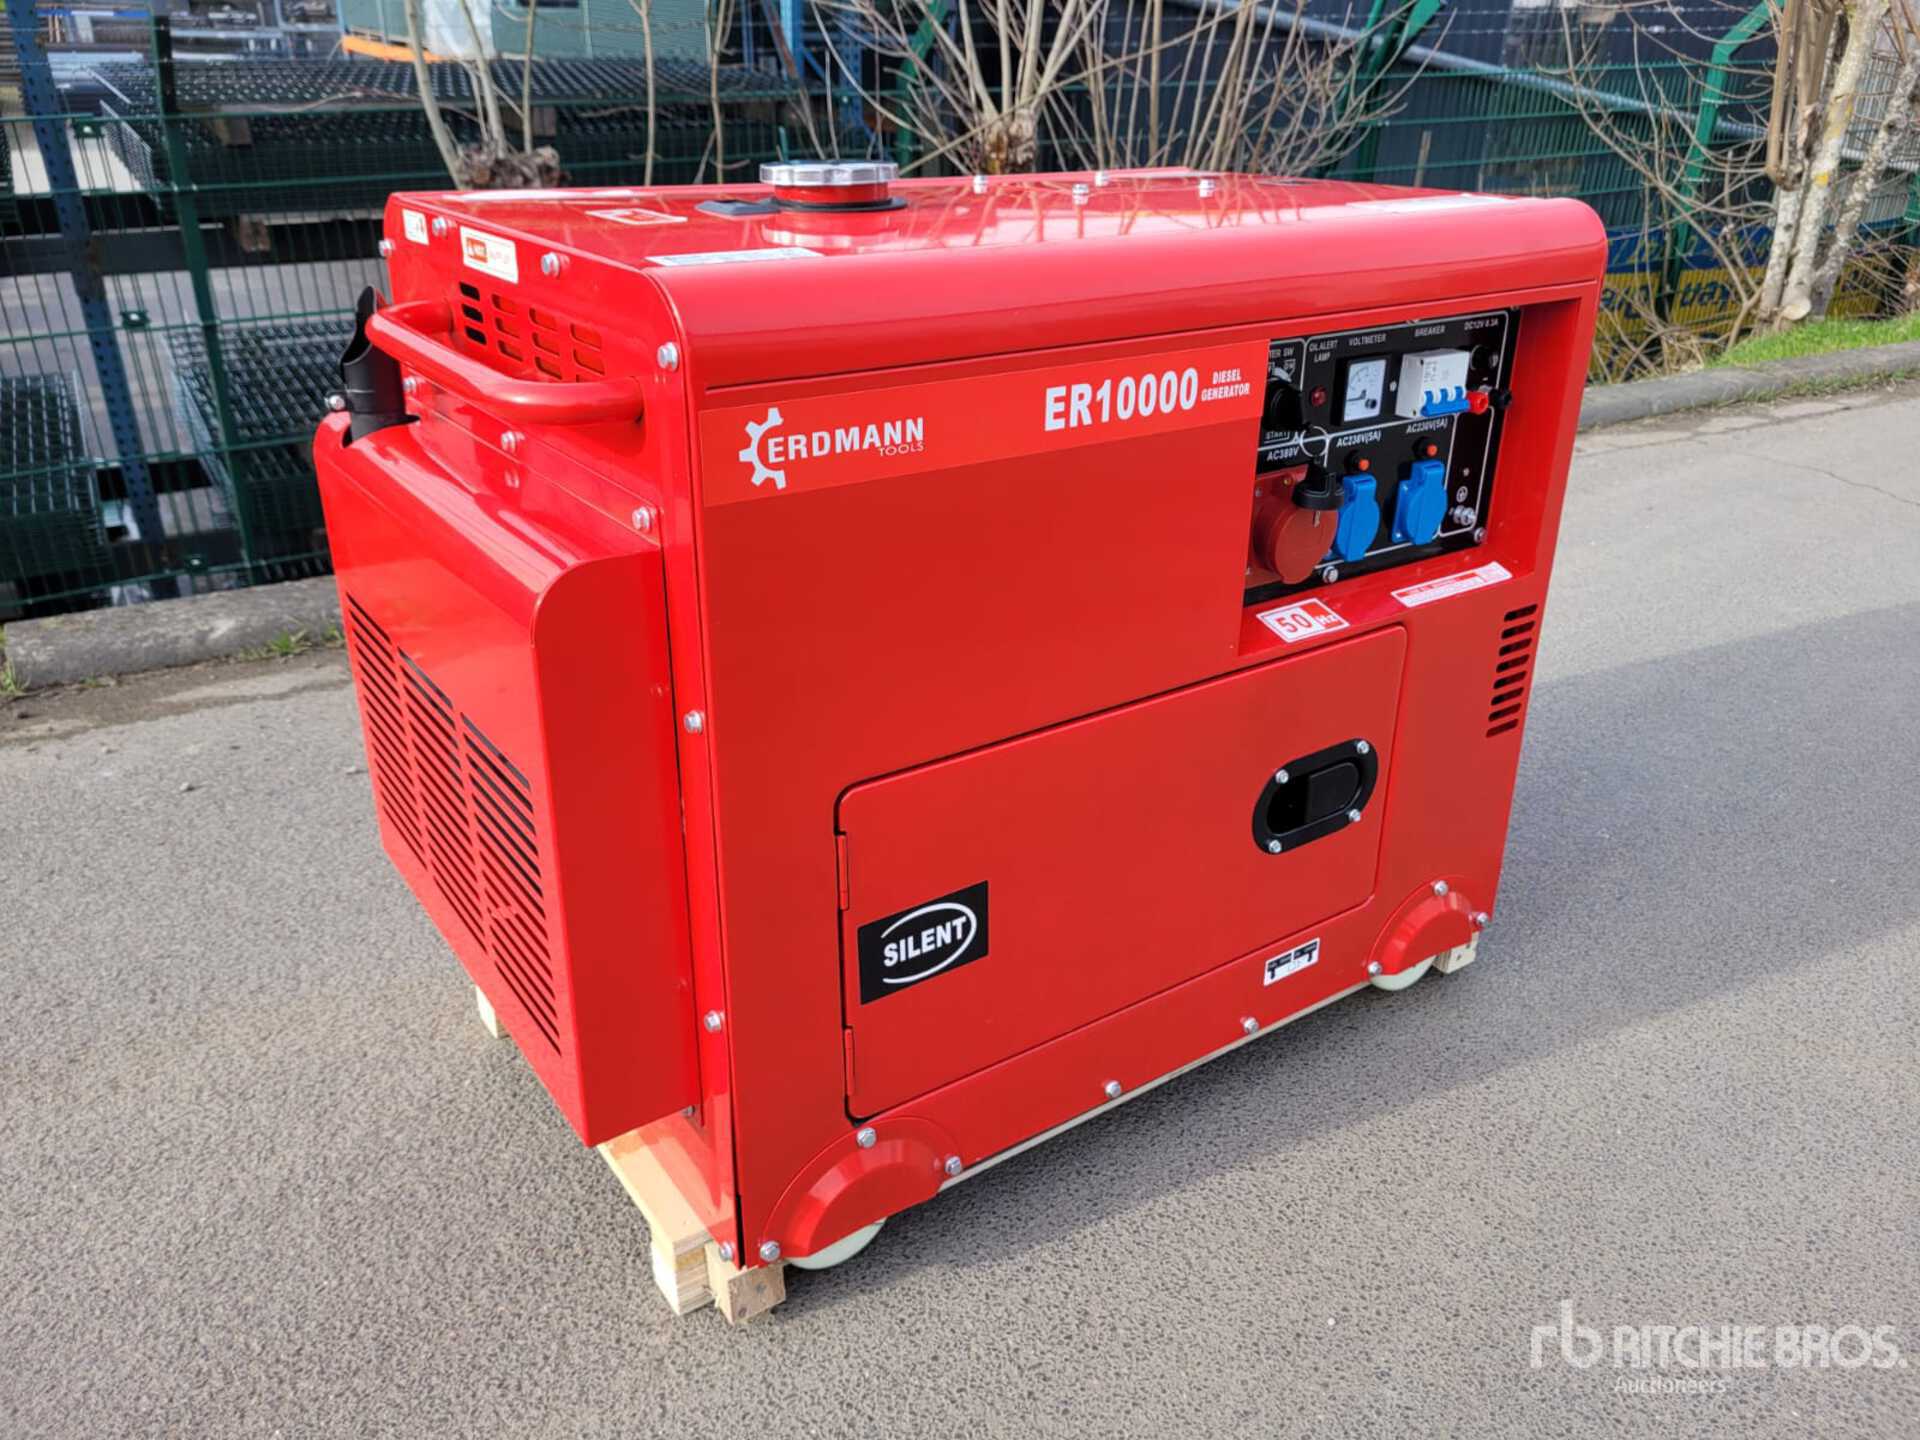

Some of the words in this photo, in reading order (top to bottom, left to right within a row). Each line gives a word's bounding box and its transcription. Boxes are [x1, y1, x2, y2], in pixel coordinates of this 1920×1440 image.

[1349, 333, 1386, 346] VOLTMETER
[1414, 325, 1446, 338] BREAKER
[1313, 351, 1331, 363] LAMP
[1212, 369, 1242, 385] DIESEL
[1043, 367, 1198, 432] ER10000
[1201, 382, 1250, 402] GENERATOR
[767, 417, 924, 465] ERDMANN
[878, 441, 925, 457] TOOLS
[1266, 446, 1300, 462] AC380V
[1275, 612, 1312, 633] 50
[883, 915, 967, 967] SILENT
